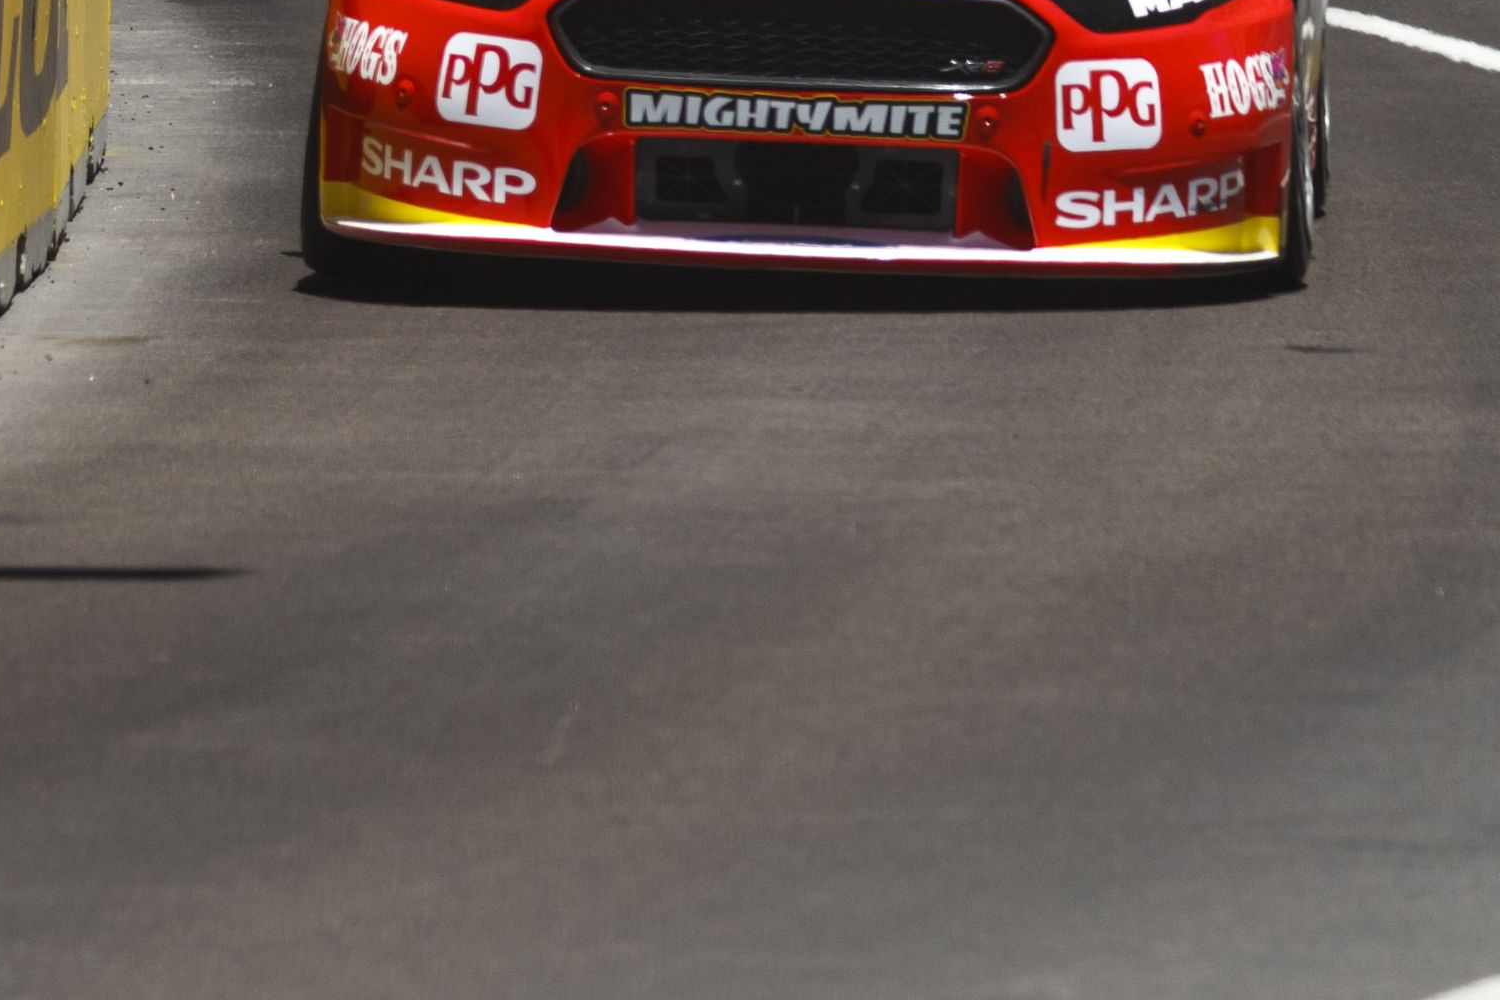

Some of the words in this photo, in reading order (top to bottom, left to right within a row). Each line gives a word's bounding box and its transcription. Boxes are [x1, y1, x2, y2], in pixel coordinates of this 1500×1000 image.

[441, 43, 537, 117] PPG
[1062, 69, 1156, 142] PPG
[360, 136, 538, 204] SHARP
[1054, 168, 1246, 229] SHARP
